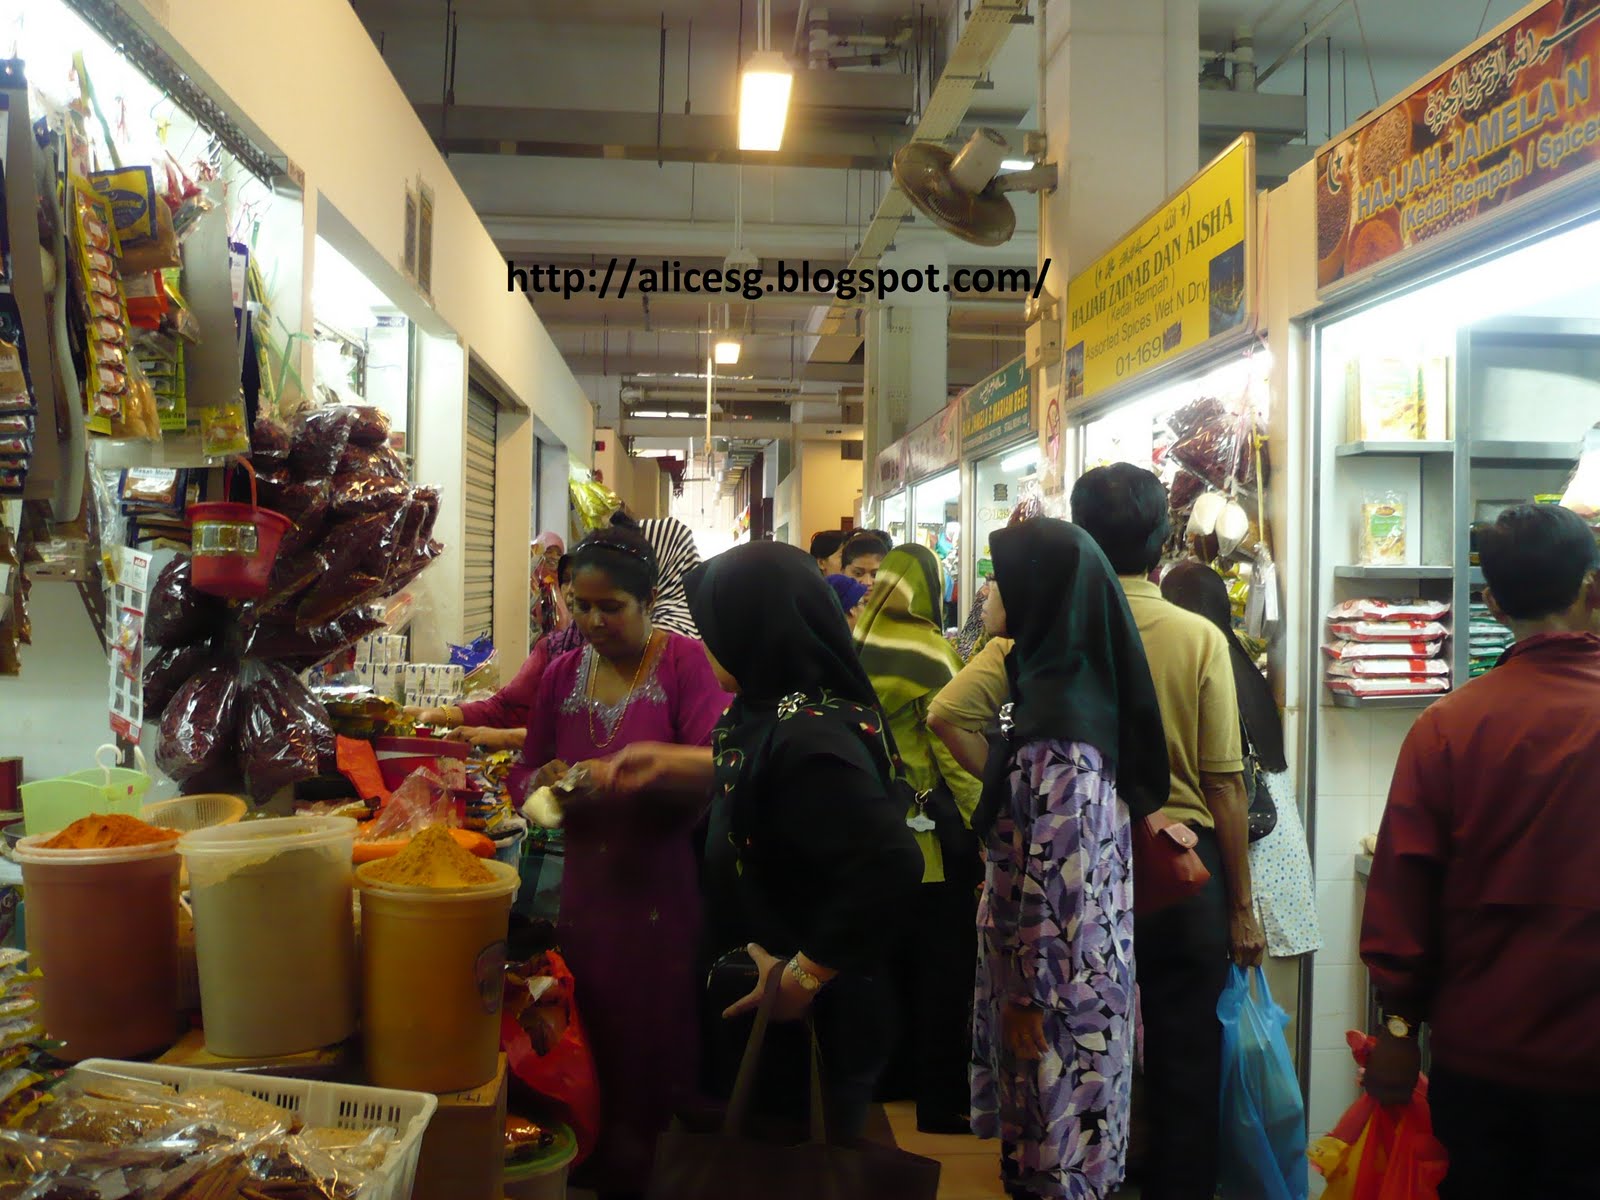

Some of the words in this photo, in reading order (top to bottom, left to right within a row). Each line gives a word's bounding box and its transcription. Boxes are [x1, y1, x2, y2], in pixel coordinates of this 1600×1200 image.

[1357, 143, 1443, 223] HAJJAH
[1452, 151, 1524, 208] Rempah
[1537, 115, 1600, 168] Spice
[1072, 290, 1107, 332] HAJJAH
[1109, 259, 1151, 308] ZAINAB
[1154, 234, 1182, 277] DAN
[1185, 197, 1233, 256] AISHA
[1085, 327, 1119, 361] Assorted
[1121, 313, 1152, 342] Spices
[1154, 295, 1174, 322] Wet
[1176, 288, 1185, 311] N
[1187, 279, 1208, 304] Dry
[1115, 336, 1161, 377] 01-169
